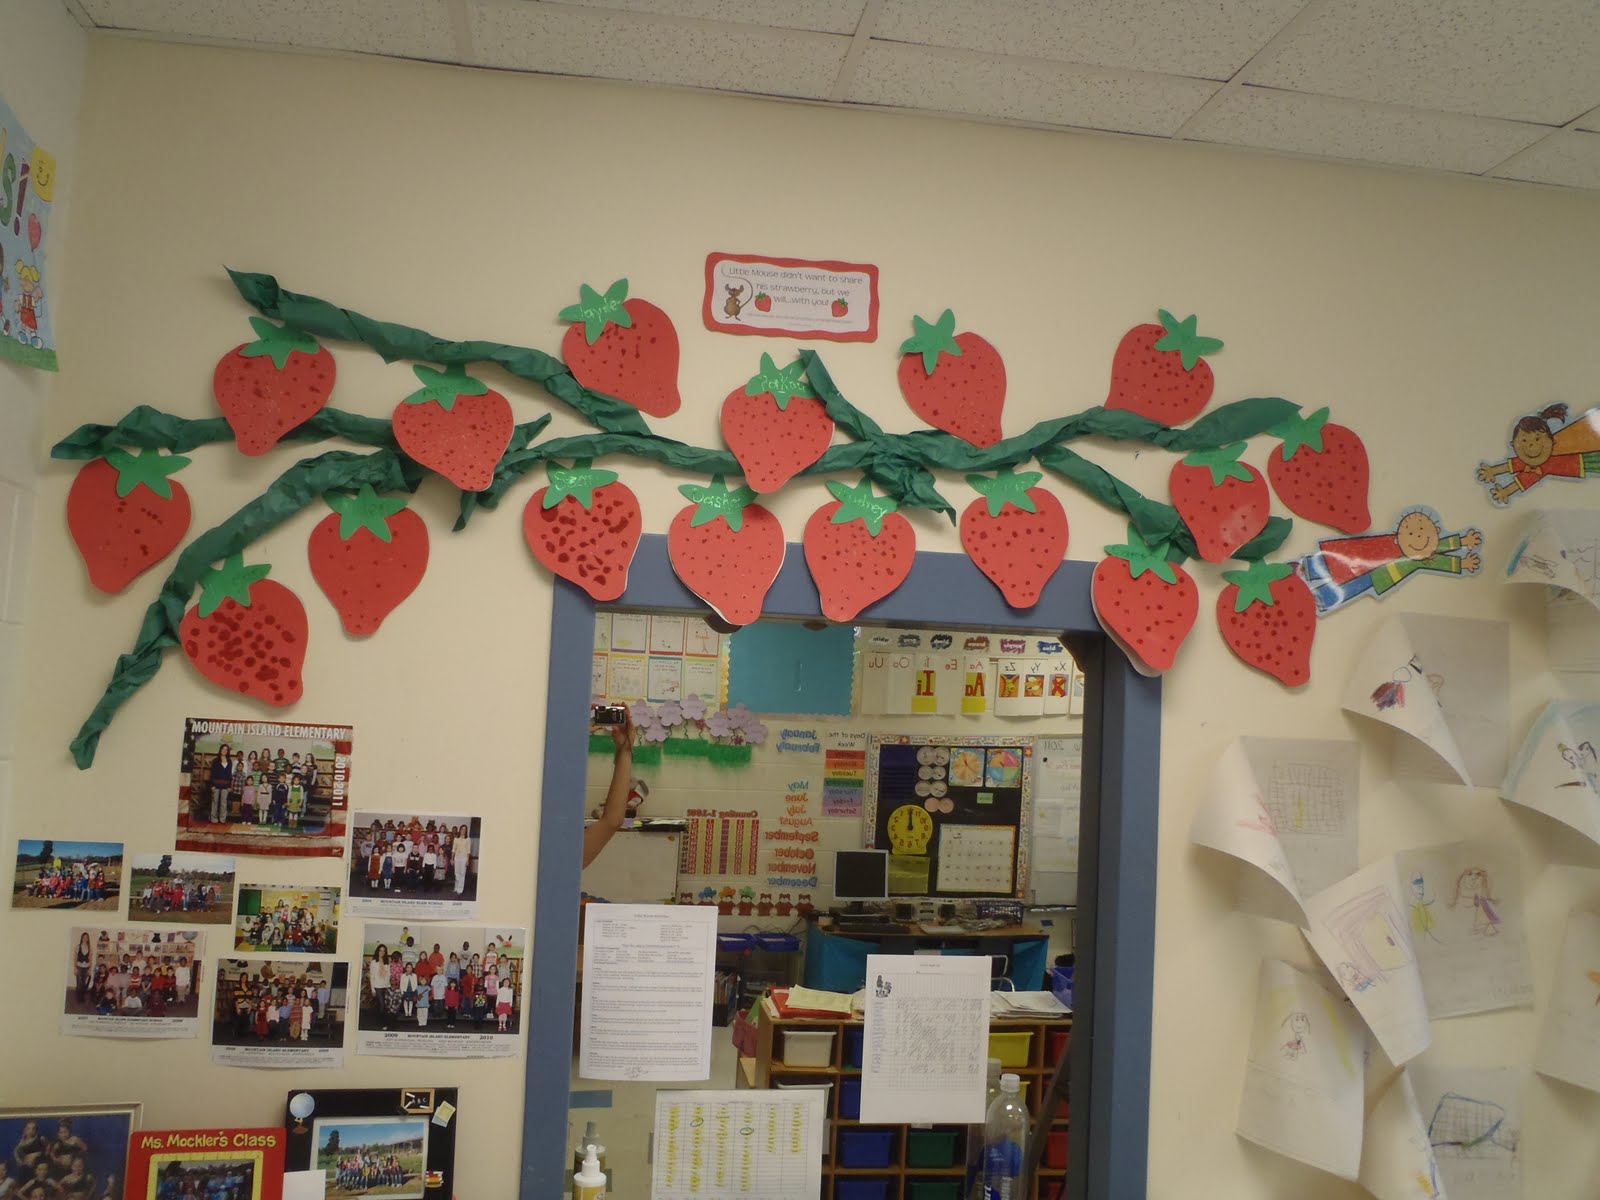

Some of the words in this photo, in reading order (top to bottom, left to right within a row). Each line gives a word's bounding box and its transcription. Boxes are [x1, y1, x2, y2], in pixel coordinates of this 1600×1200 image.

[729, 267, 750, 276] Little
[752, 269, 778, 278] Mouse
[780, 272, 802, 281] didn't
[804, 274, 826, 282] want
[840, 276, 863, 285] share
[756, 282, 768, 290] his
[770, 284, 820, 296] strawberry,
[821, 288, 835, 296] but
[811, 299, 830, 307] you!
[192, 721, 244, 735] MOUNTAIN
[248, 724, 282, 737] ISLAND
[284, 726, 347, 740] ELEMENTARY
[332, 756, 346, 807] 2010-2011
[141, 1135, 164, 1150] Ms.
[166, 1130, 229, 1148] Mockler's
[232, 1133, 276, 1148] Class
